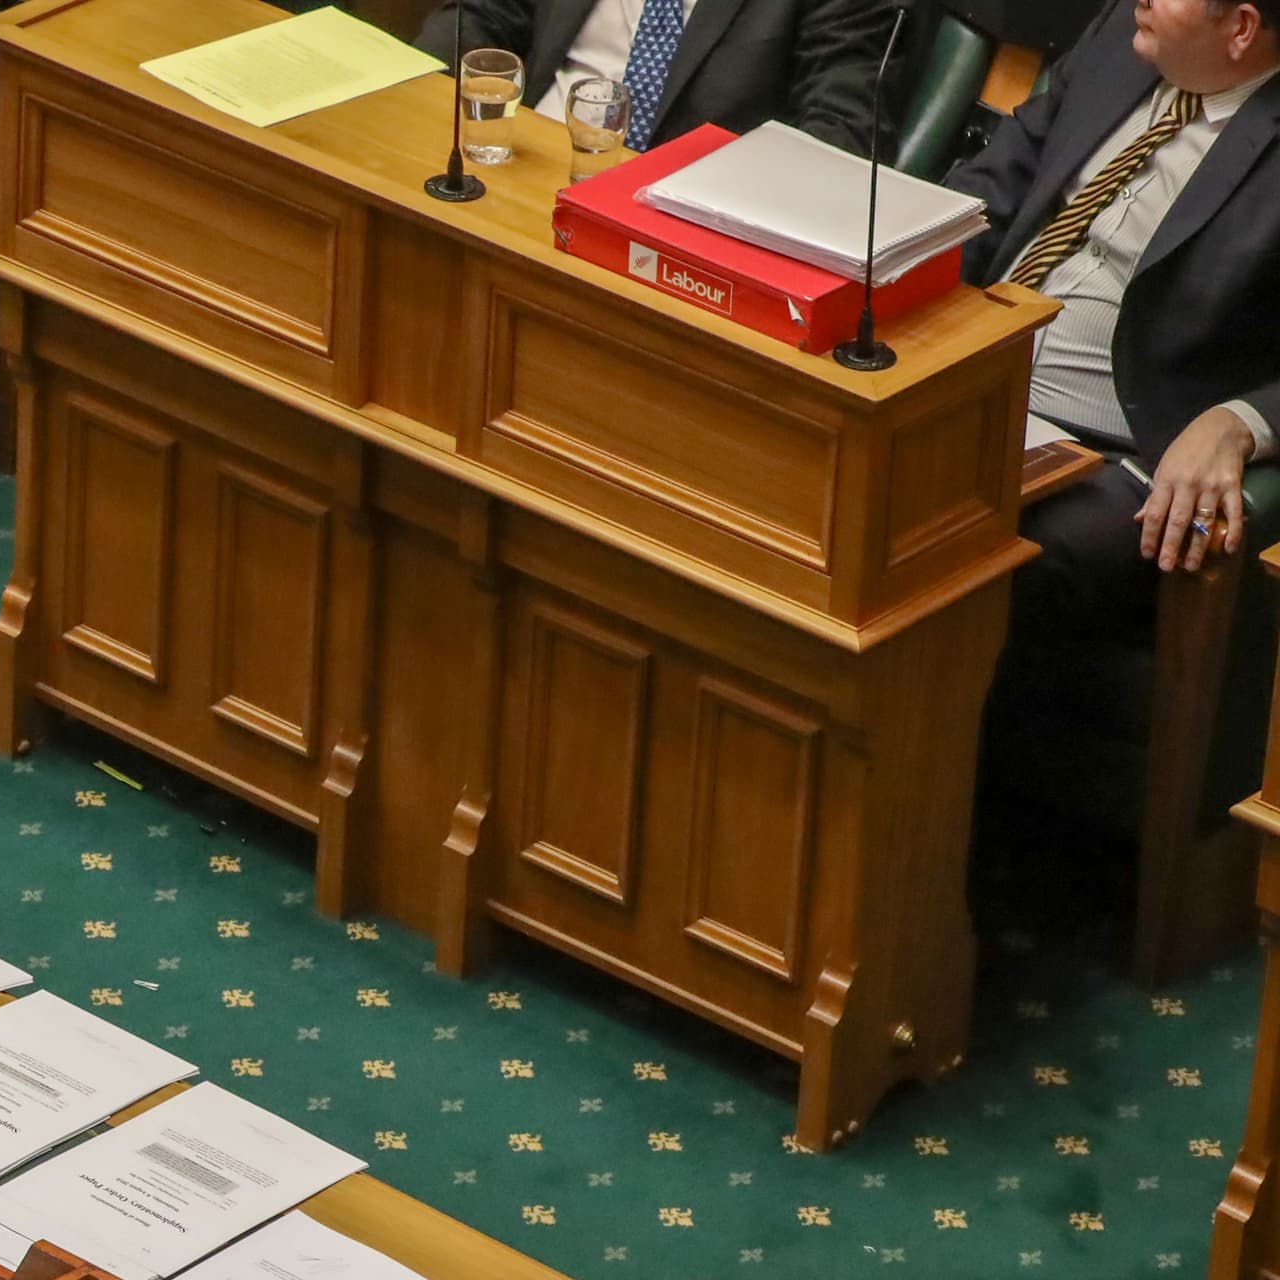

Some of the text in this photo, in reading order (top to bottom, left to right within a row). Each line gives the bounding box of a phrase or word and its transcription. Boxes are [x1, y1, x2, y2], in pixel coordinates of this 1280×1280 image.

[662, 263, 726, 304] Labour
[79, 1174, 189, 1233] Supplementary Order Paper
